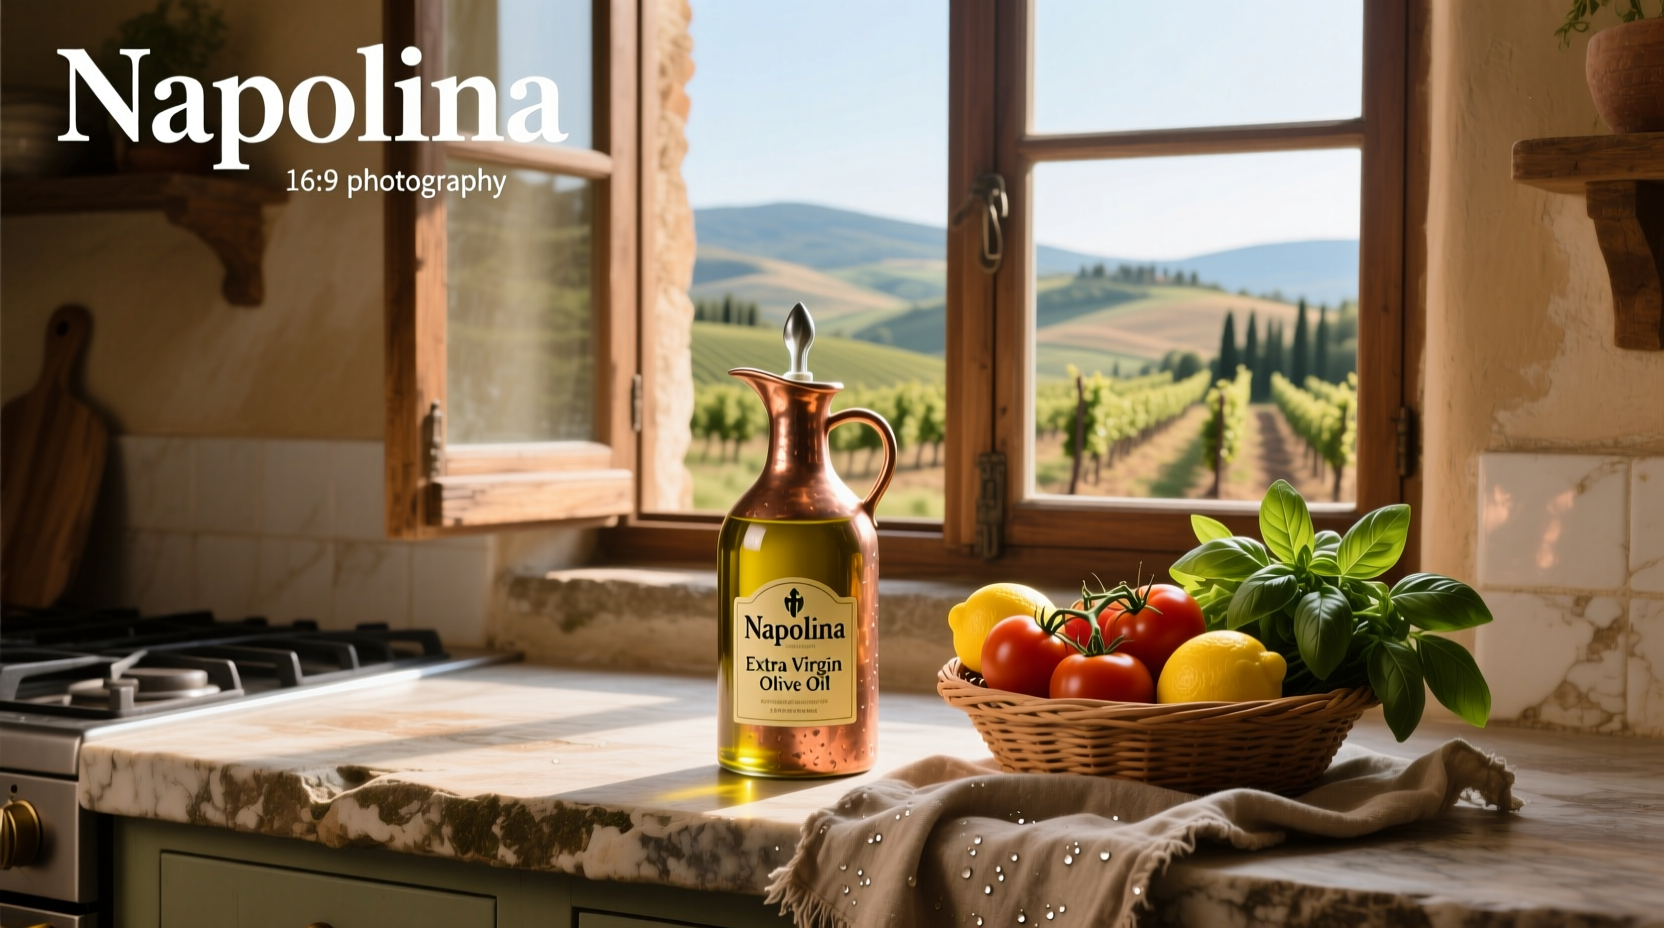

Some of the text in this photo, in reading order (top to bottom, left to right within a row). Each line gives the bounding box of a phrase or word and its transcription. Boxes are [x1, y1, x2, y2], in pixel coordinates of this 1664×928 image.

[744, 615, 846, 647] Napolina
[746, 656, 842, 676] Extra Virgin
[759, 675, 831, 692] Olive Oil
